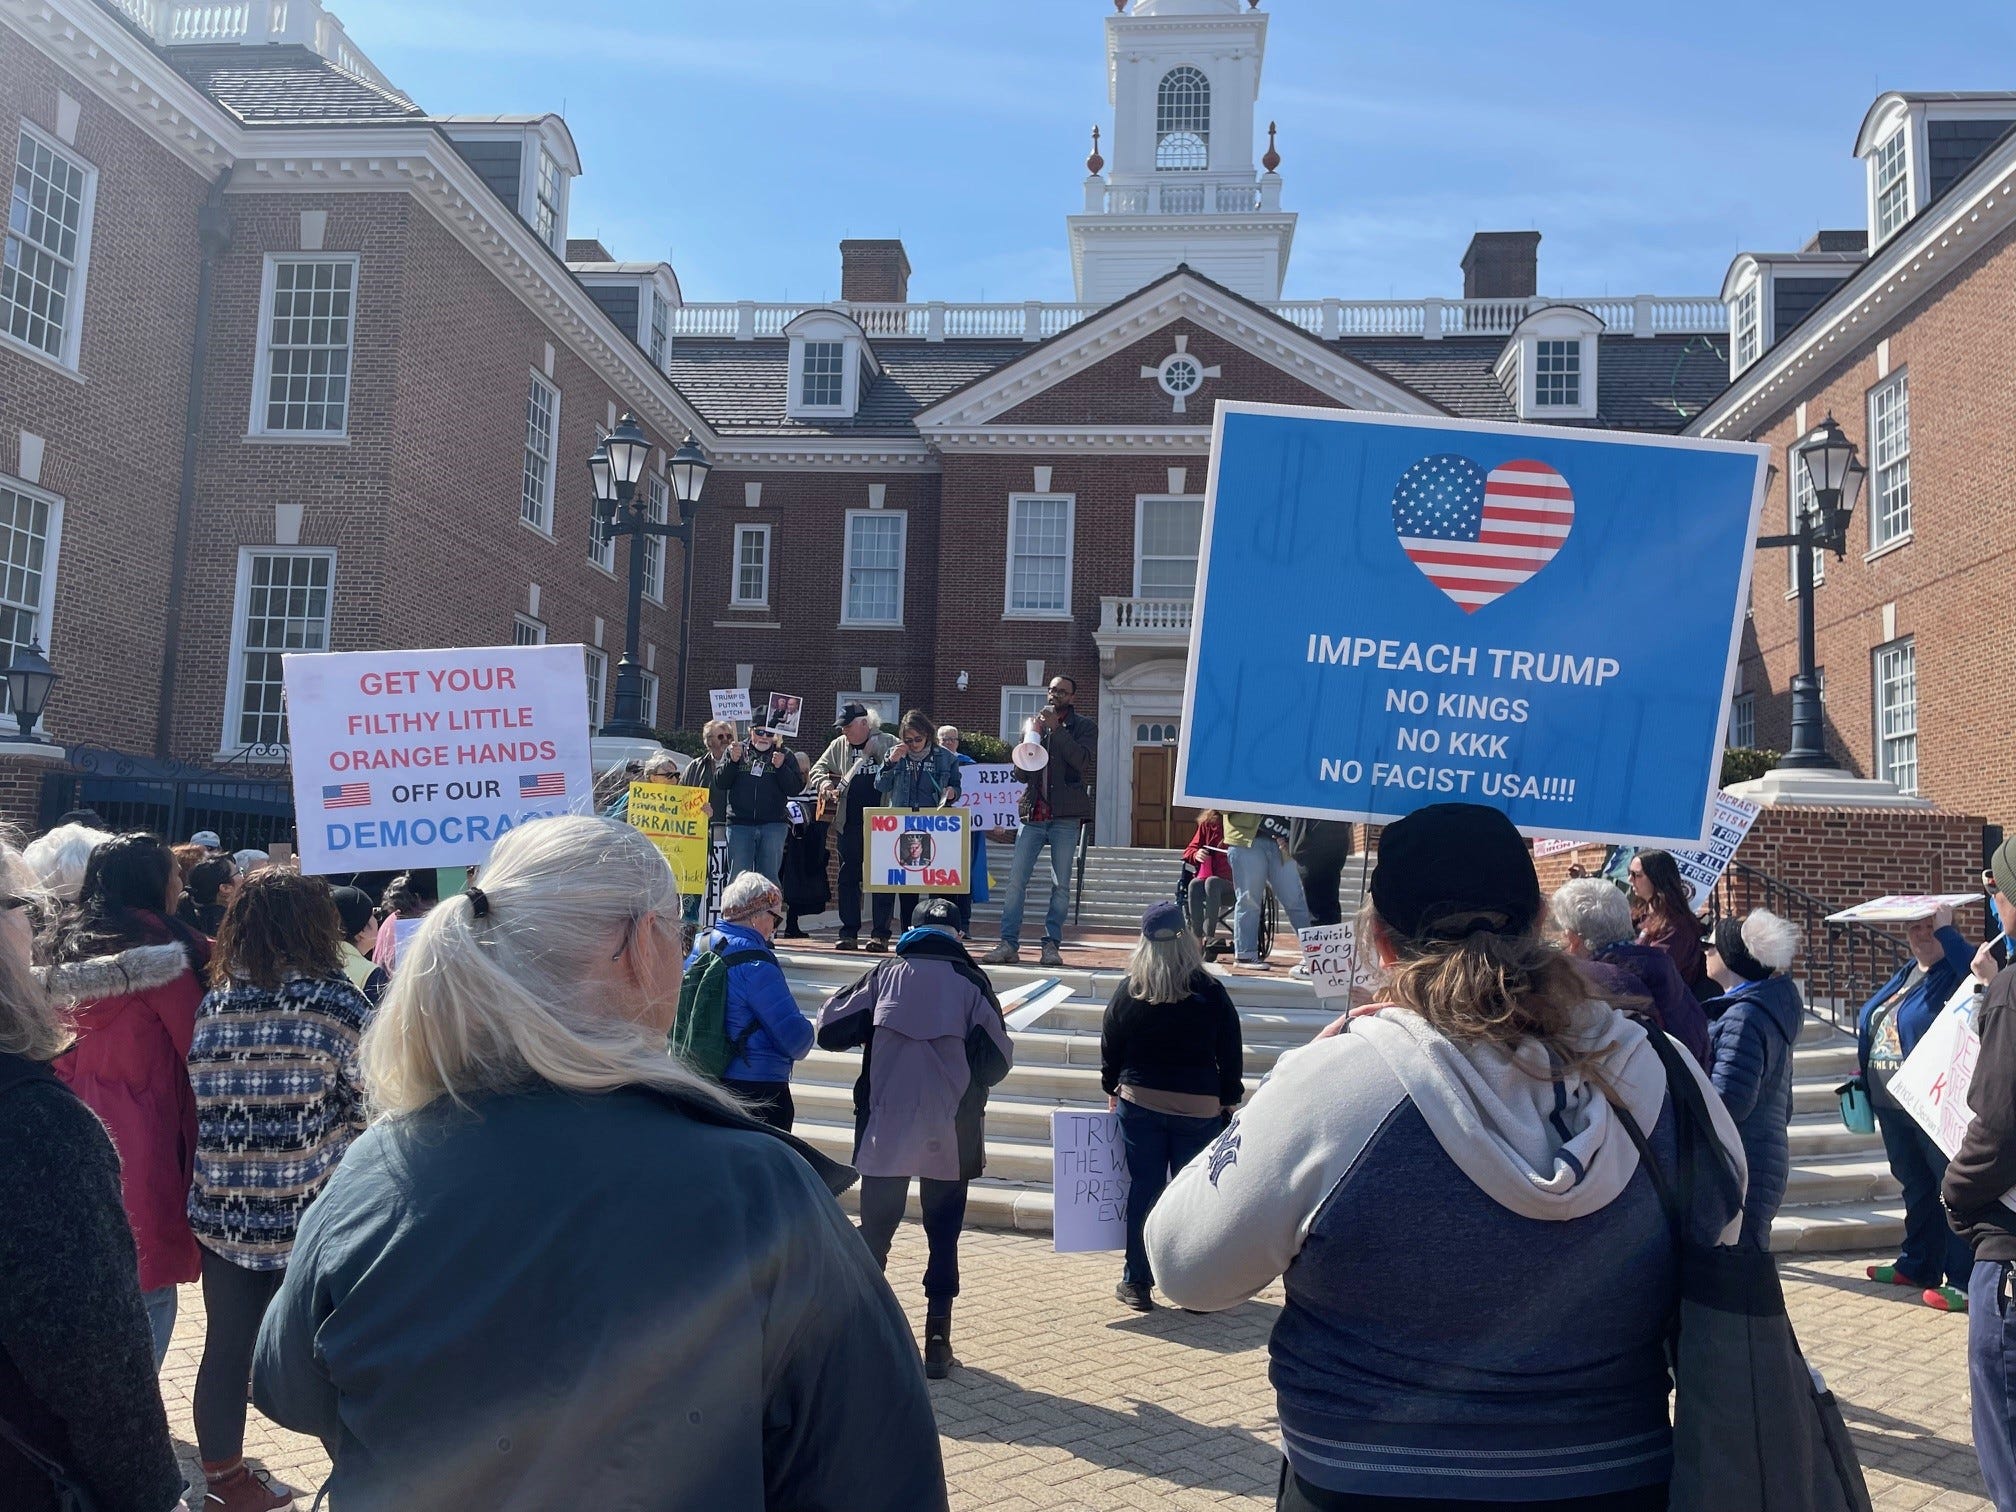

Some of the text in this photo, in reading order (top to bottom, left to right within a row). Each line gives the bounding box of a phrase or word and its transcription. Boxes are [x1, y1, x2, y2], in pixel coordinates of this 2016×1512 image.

[1307, 633, 1620, 687] IMPEACH TRUMP
[360, 667, 516, 696] GET YOUR
[1385, 688, 1530, 723] NO KINGS
[348, 707, 534, 736] FILTHY LITTLE
[329, 741, 557, 772] ORANGE HANDS
[1397, 727, 1510, 760] NO KKK
[392, 780, 501, 803] OFF OUR
[1320, 758, 1576, 802] NO FACIST USA!!!!
[633, 786, 682, 803] Russia
[961, 790, 1023, 807] 224-312
[1717, 791, 1758, 814] OCRACY
[326, 811, 568, 850] DEMOCRA
[871, 815, 961, 832] NO KINGS
[1719, 829, 1739, 844] FOR
[1701, 855, 1721, 871] ALL
[887, 869, 961, 886] IN USA
[1300, 926, 1352, 942] Indivisib
[1071, 1116, 1119, 1147] TRU
[1060, 1149, 1103, 1175] THE
[1074, 1179, 1132, 1205] PRES
